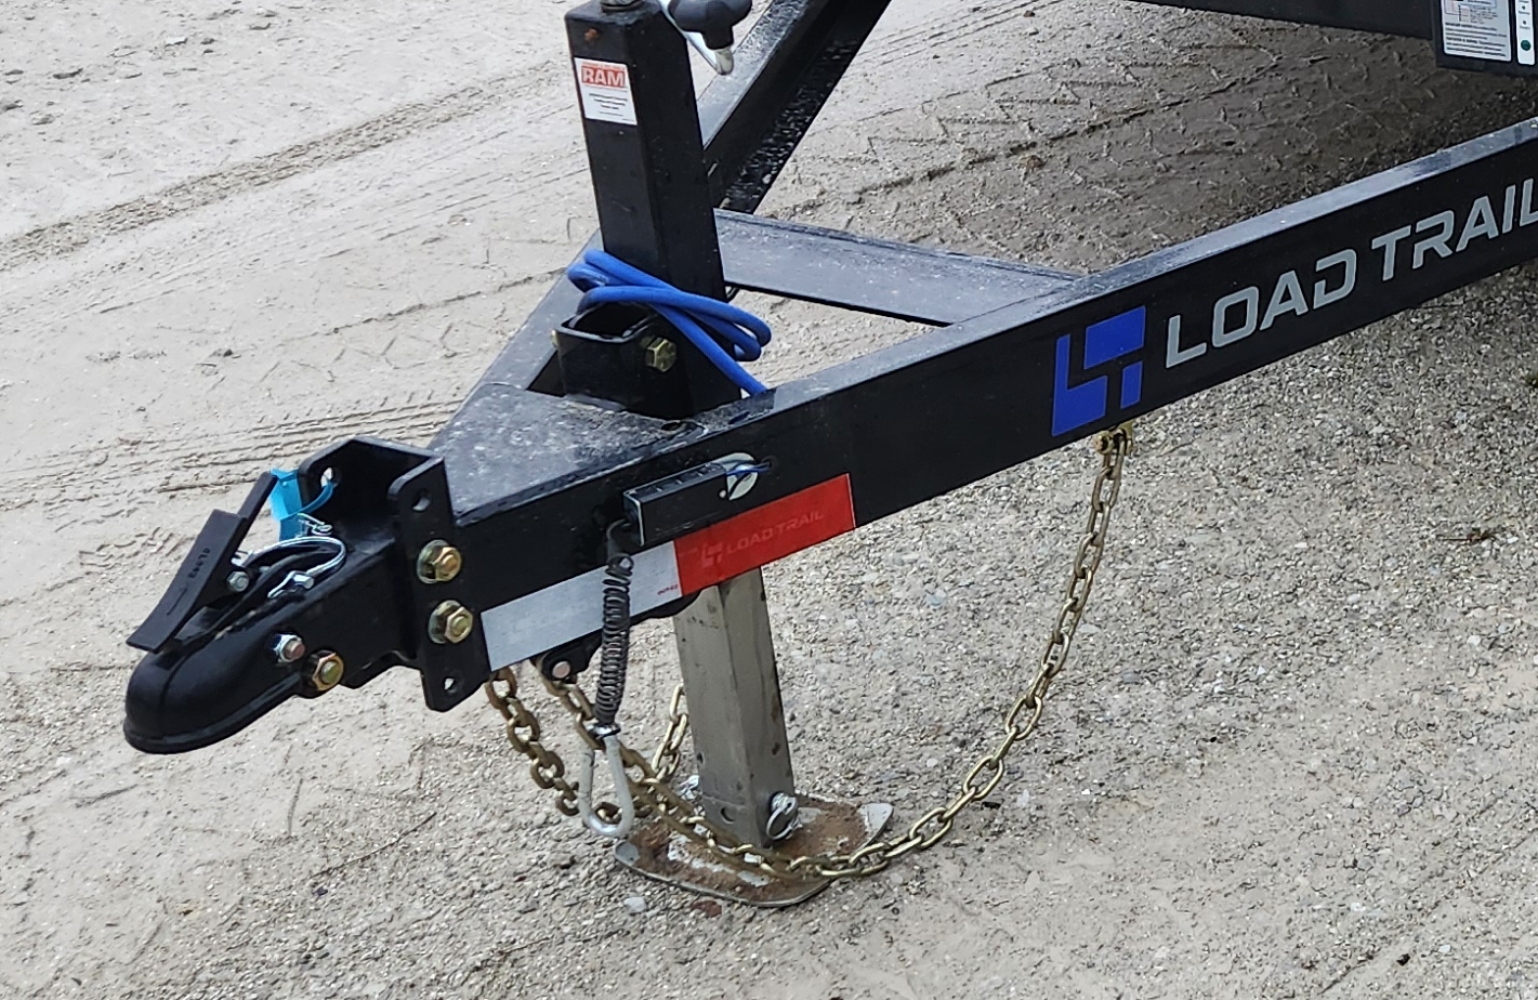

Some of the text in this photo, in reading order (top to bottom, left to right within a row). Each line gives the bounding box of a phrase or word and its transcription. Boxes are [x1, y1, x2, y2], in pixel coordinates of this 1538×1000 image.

[582, 67, 625, 88] RAM
[1166, 249, 1357, 368] LOAD
[726, 527, 774, 554] LOAD
[776, 510, 824, 536] TRAIL
